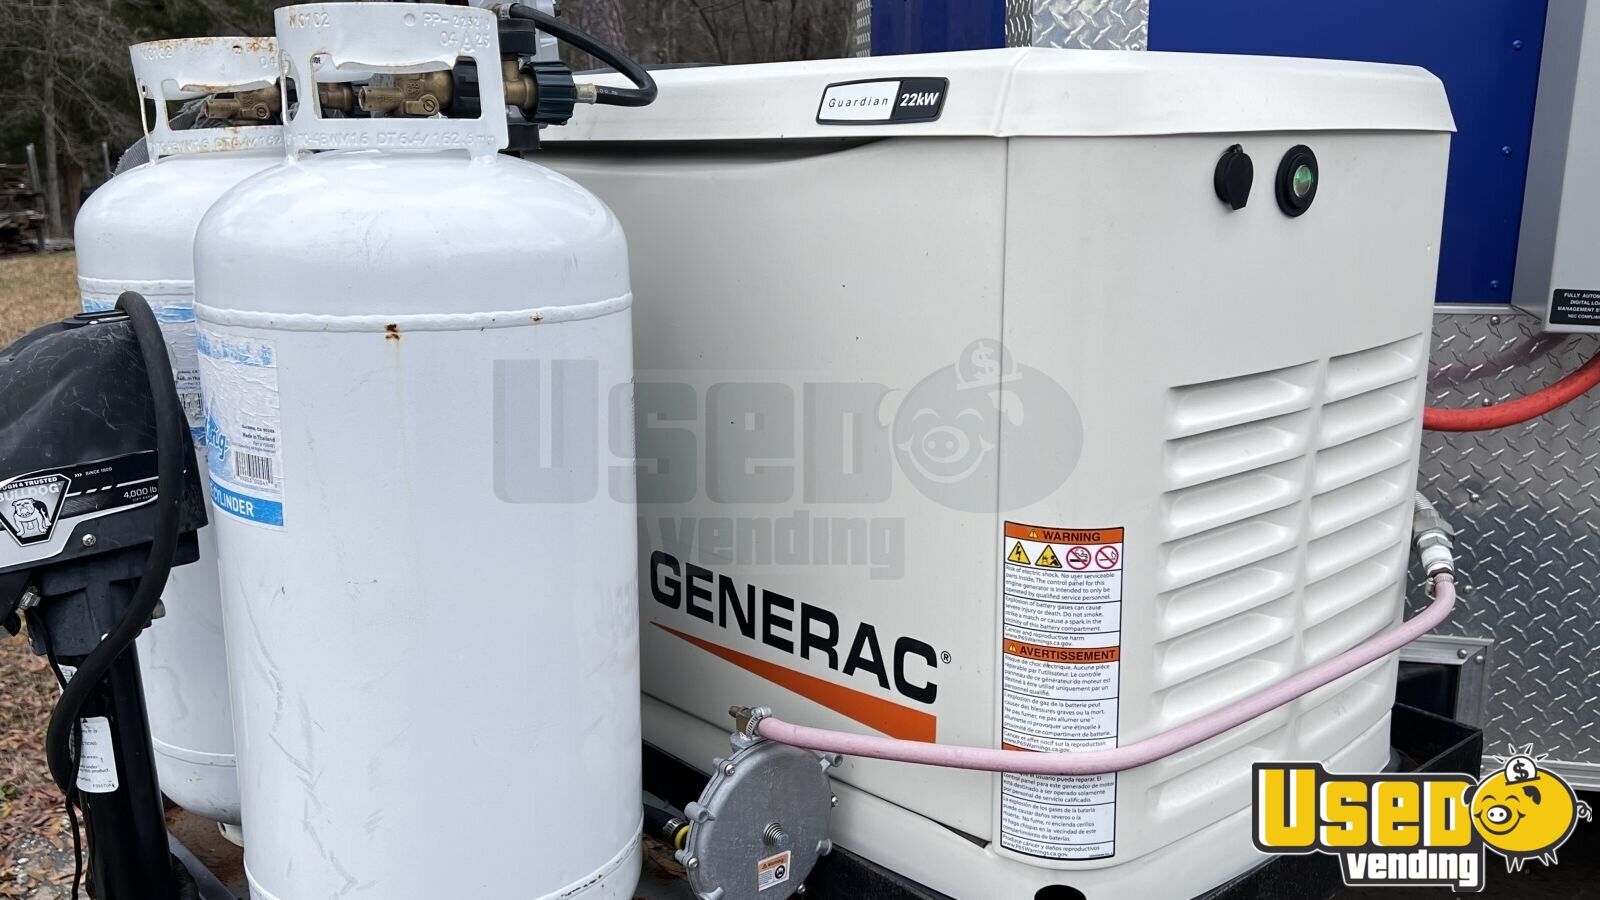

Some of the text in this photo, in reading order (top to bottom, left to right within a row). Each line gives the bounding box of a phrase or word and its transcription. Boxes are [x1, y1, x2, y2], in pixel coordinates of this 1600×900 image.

[828, 91, 940, 108] Guardian 22kW
[24, 476, 58, 487] TRUSTED
[123, 488, 149, 499] 4,000
[149, 486, 158, 494] lb
[1043, 530, 1101, 542] WARNING
[1022, 568, 1041, 576] electric
[1023, 582, 1049, 592] generator
[1036, 592, 1060, 601] qualified
[1036, 602, 1056, 610] battery
[1023, 613, 1039, 621] match
[650, 550, 938, 705] GENERAC
[1040, 623, 1060, 632] battery
[1033, 631, 1068, 642] reproductive
[1020, 646, 1116, 661] AVERTISSEMENT
